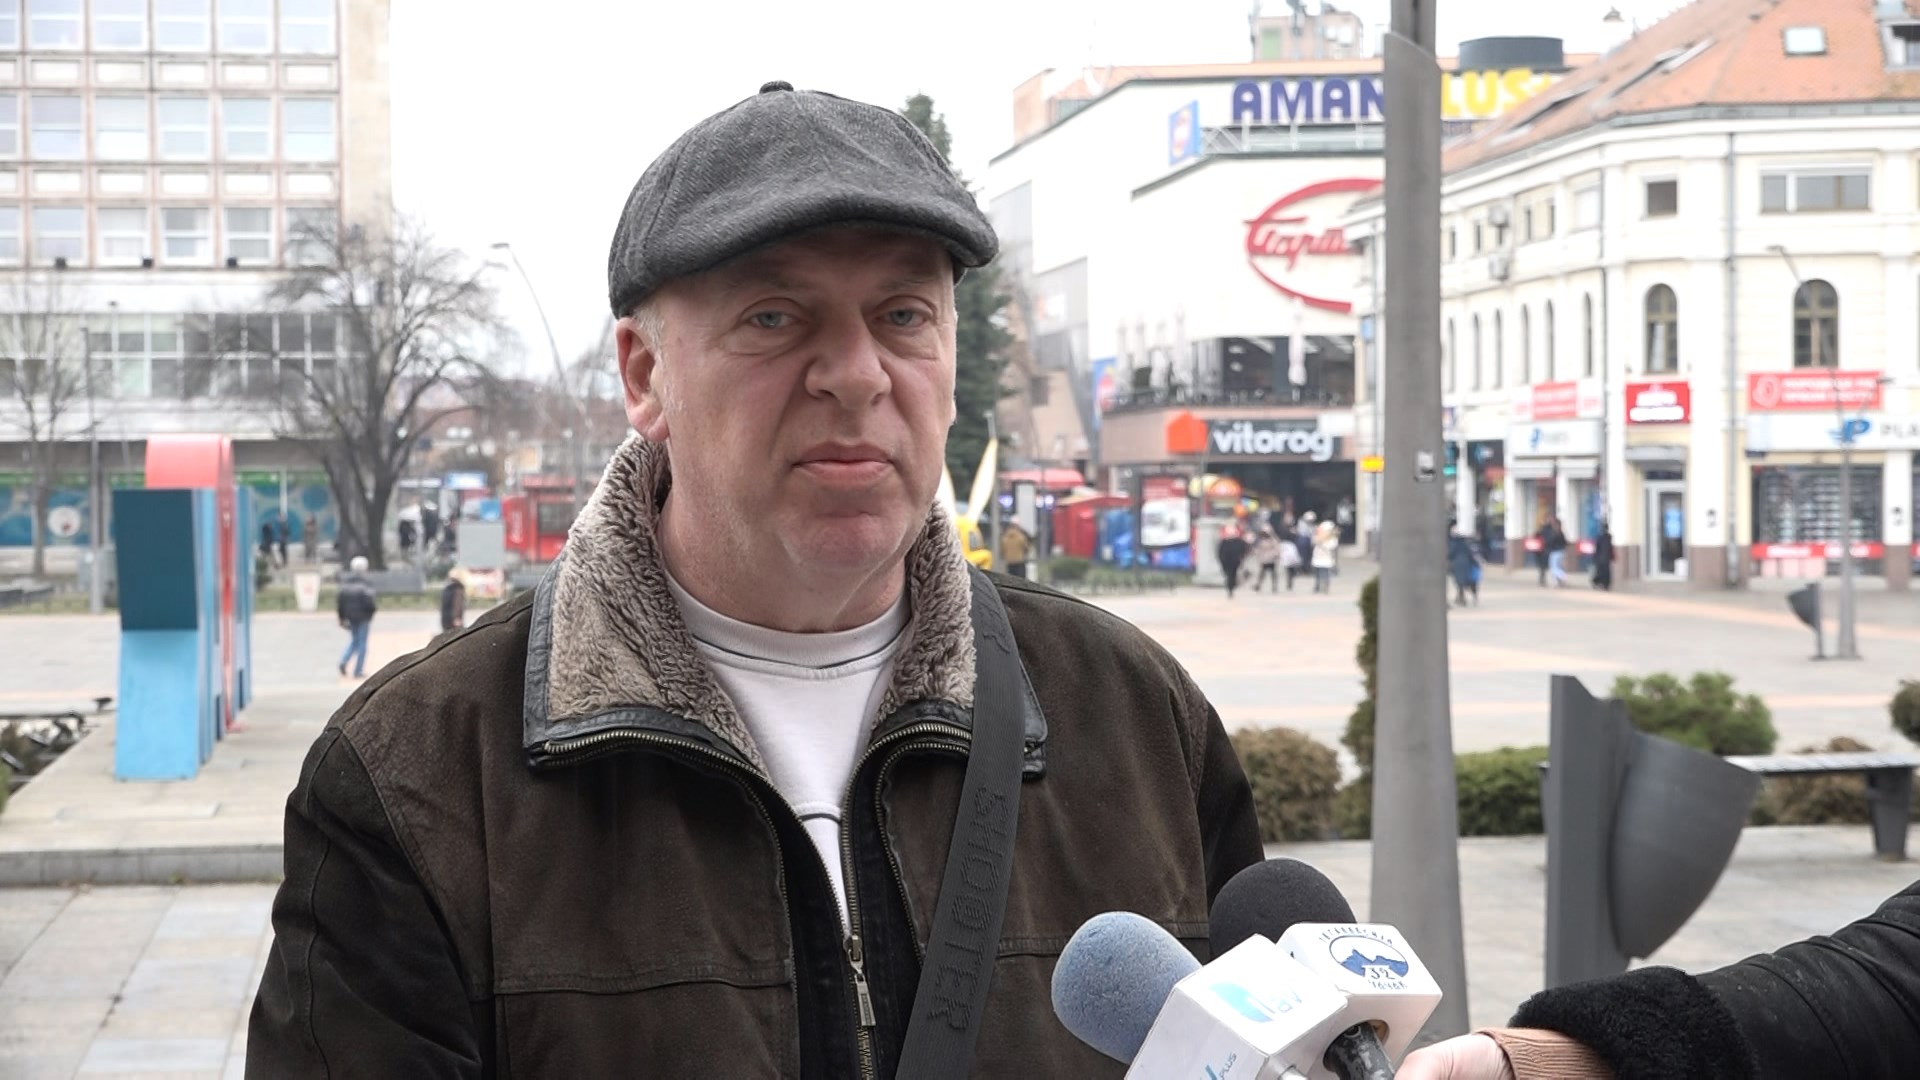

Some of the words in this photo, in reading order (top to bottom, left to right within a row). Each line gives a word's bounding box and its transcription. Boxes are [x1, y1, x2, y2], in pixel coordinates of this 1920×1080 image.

[1233, 79, 1385, 122] AMAN
[1441, 68, 1533, 117] LUS
[1213, 421, 1334, 462] vitorog
[927, 786, 1009, 1031] SHOOTER
